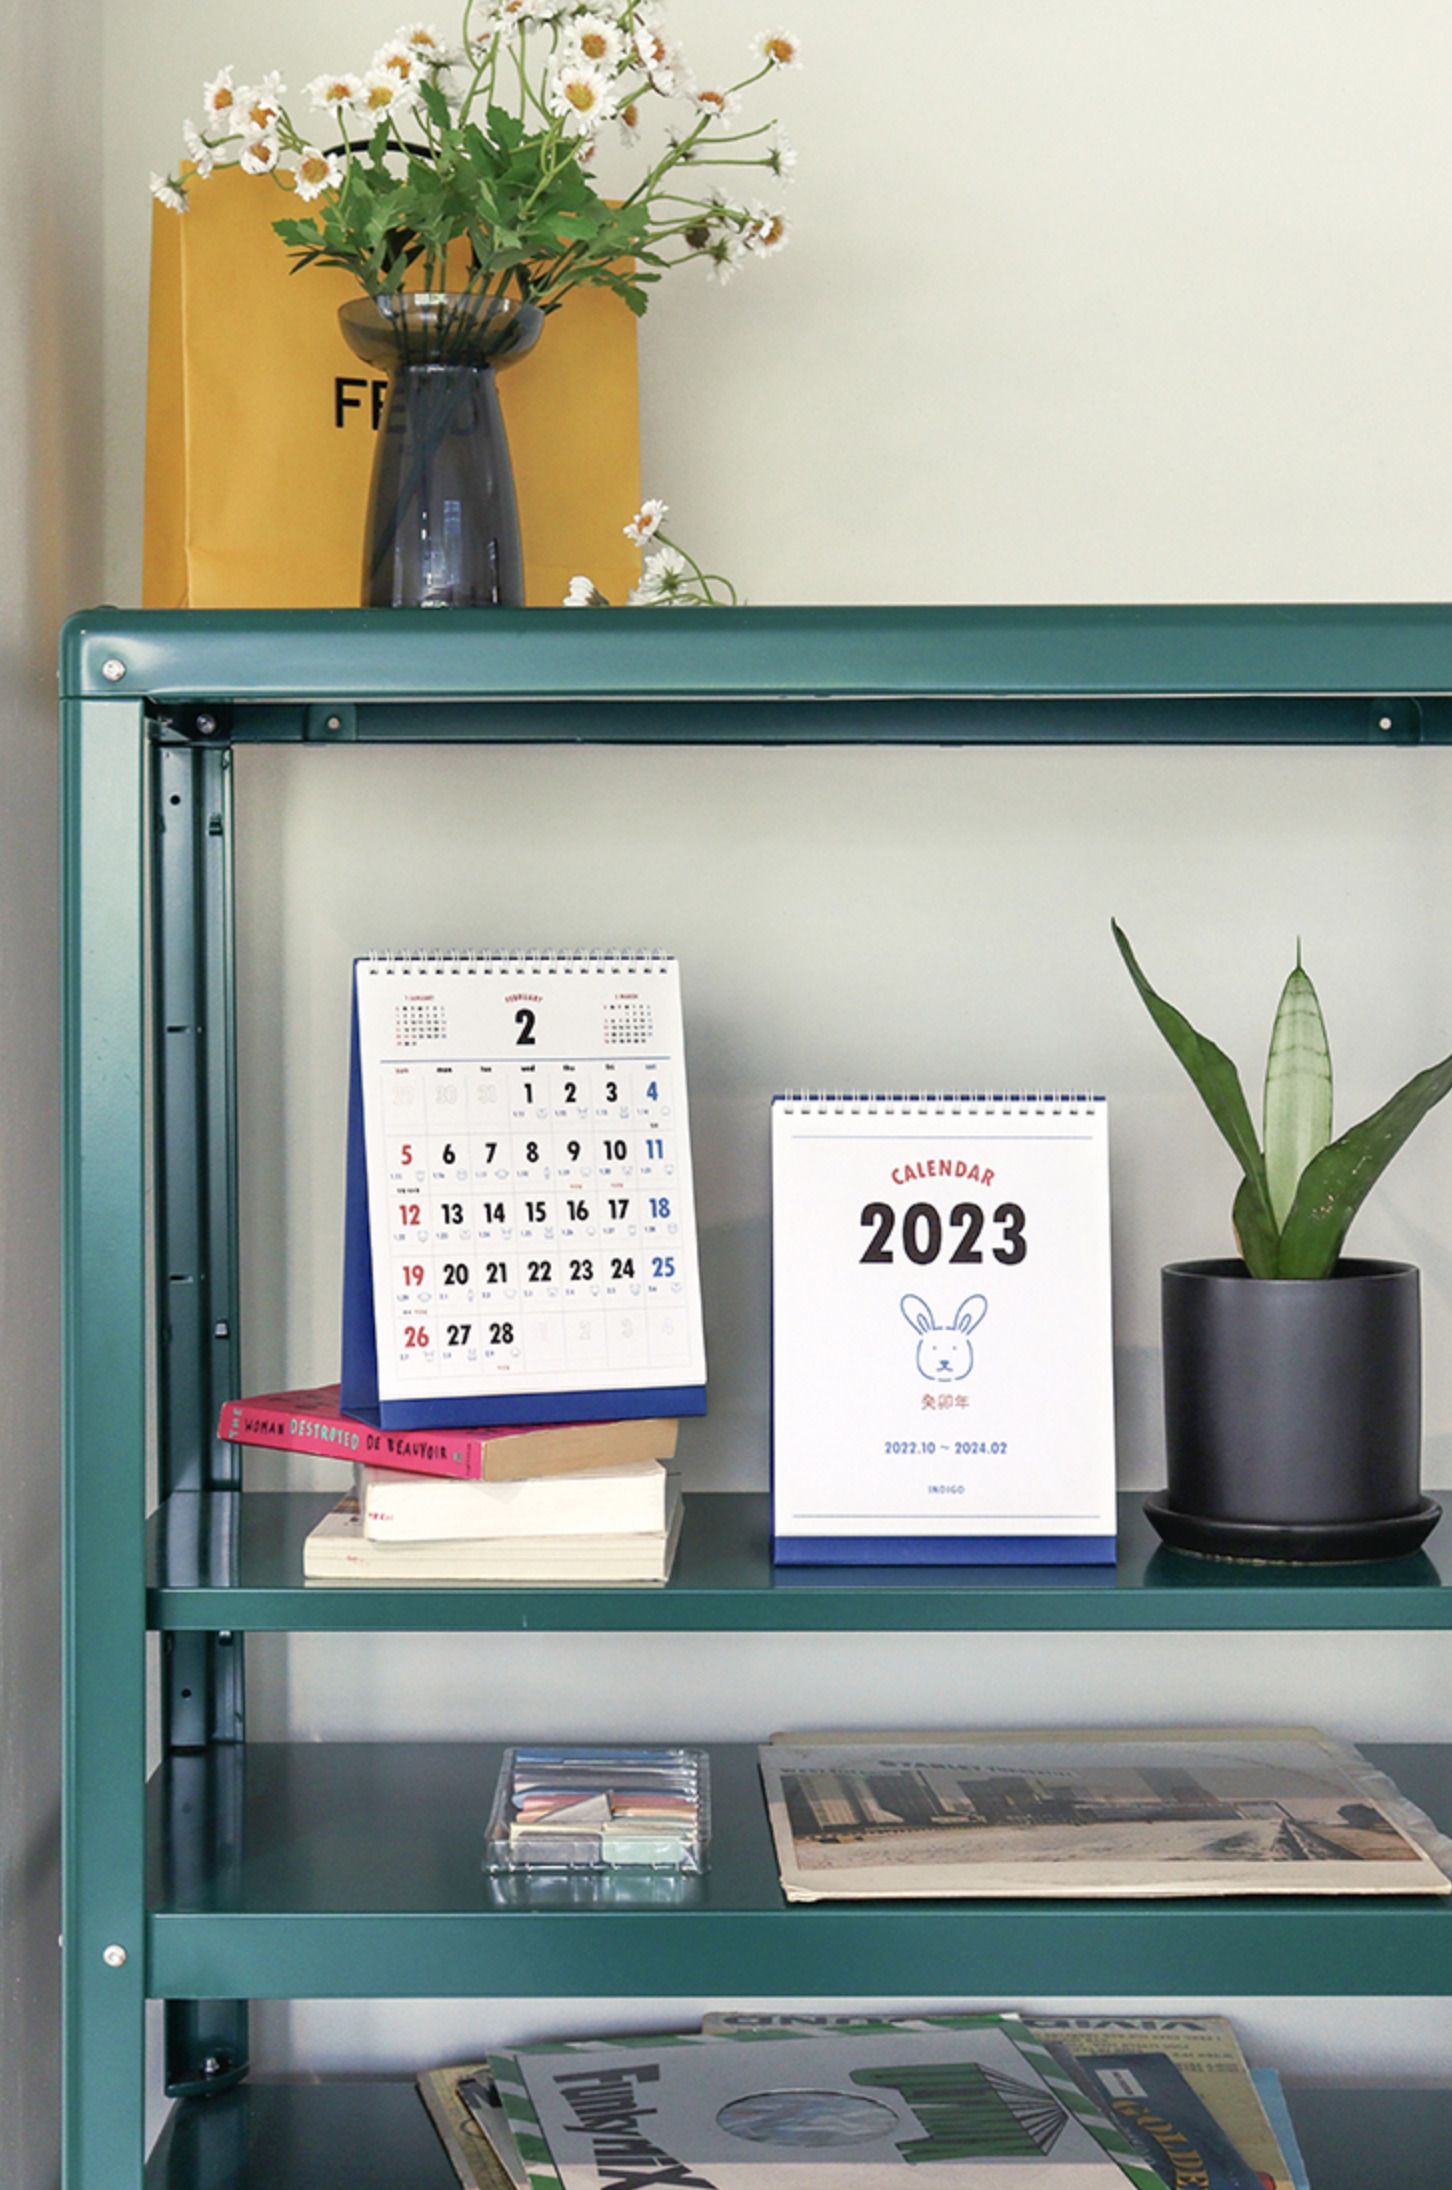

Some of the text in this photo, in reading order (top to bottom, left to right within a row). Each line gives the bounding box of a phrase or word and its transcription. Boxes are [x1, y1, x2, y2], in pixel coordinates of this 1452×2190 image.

[515, 1009, 535, 1045] 2
[524, 1083, 532, 1103] 1
[565, 1082, 576, 1102] 2
[607, 1082, 617, 1102] 3
[647, 1082, 658, 1101] 4
[402, 1139, 663, 1165] 5 6 7 8 9 10 11
[891, 1160, 995, 1186] CALENDAR
[399, 1198, 670, 1225] 12 13 14 15 16 17 18
[859, 1202, 1027, 1265] 2023
[403, 1257, 675, 1286] 19 20 21 22 23 24 25
[404, 1322, 513, 1348] 26 27 28
[922, 1394, 969, 1410] 癸卯年
[244, 1419, 285, 1435] WOMAN
[289, 1418, 360, 1450] DESTROYED
[366, 1434, 380, 1451] DE
[387, 1438, 448, 1461] BEAUVOIR
[885, 1441, 935, 1454] 2022.10
[955, 1442, 1007, 1454] 2024.02
[928, 1485, 965, 1494] INDIGO
[1111, 2098, 1211, 2190] GOLDE
